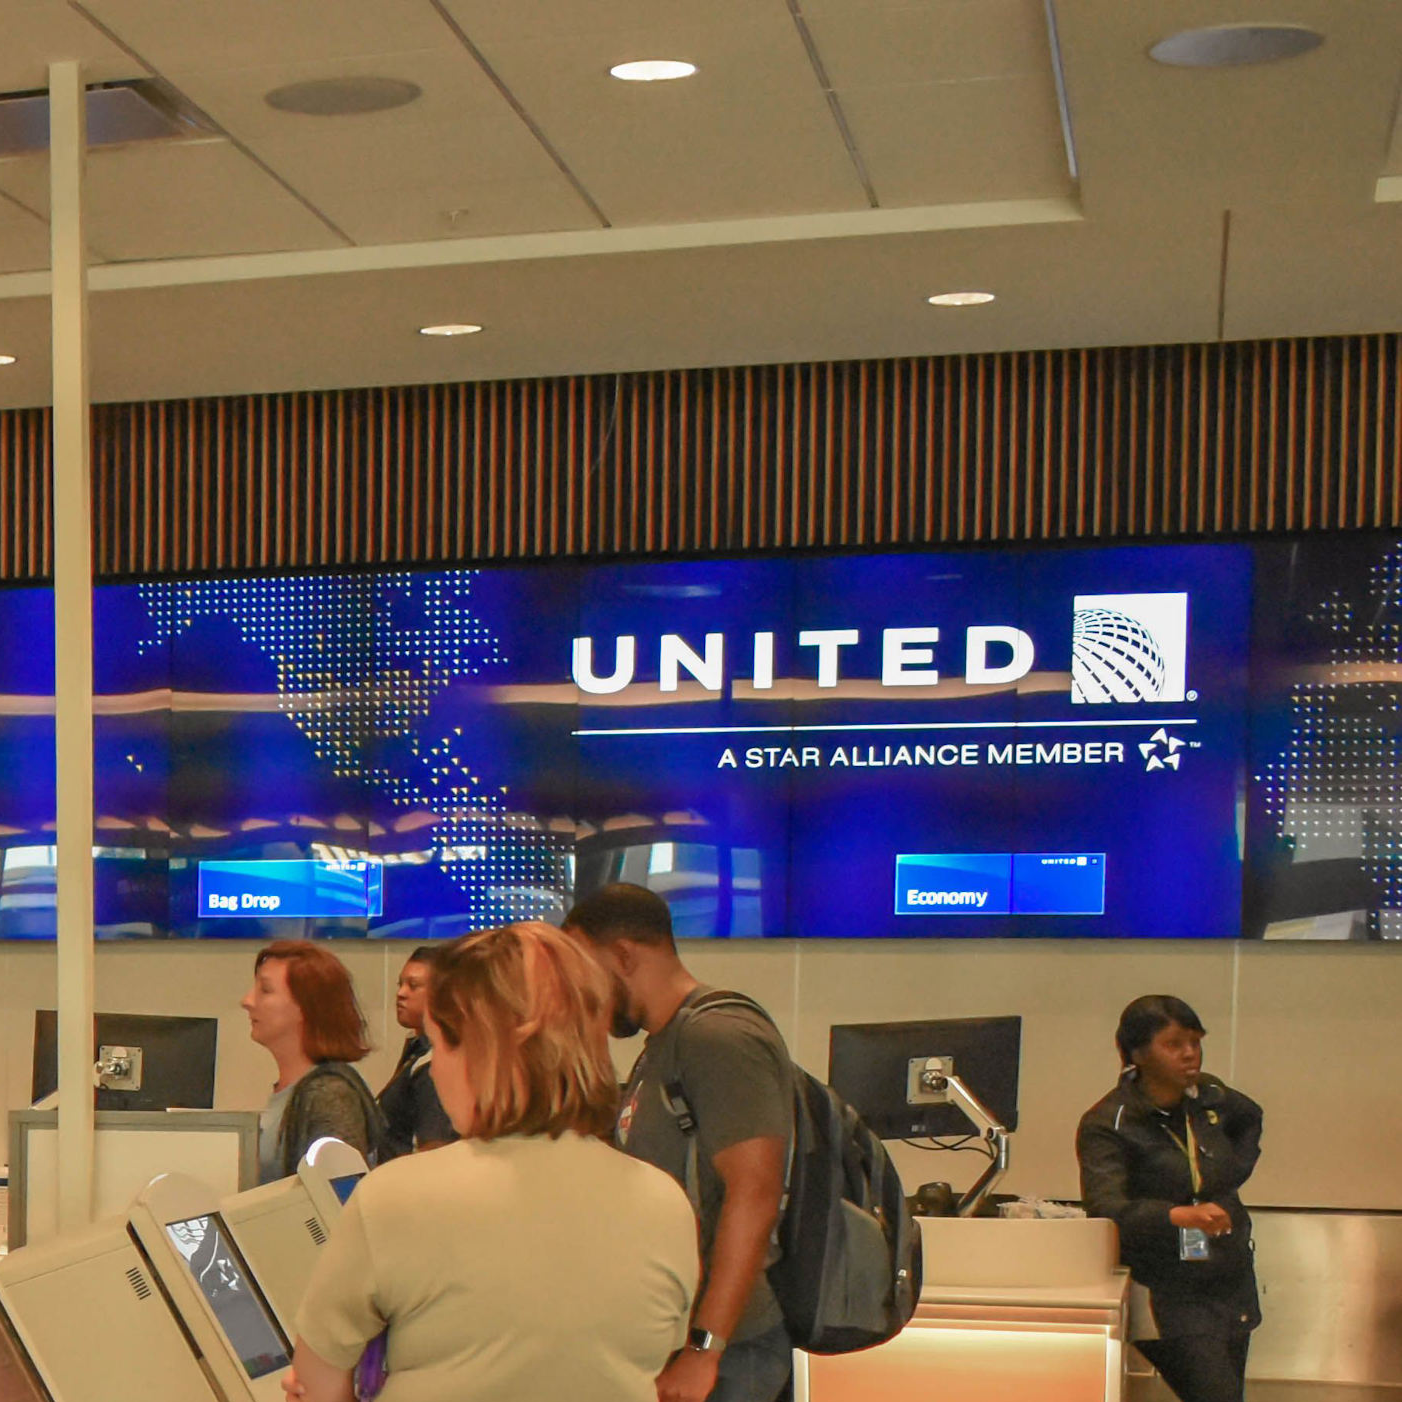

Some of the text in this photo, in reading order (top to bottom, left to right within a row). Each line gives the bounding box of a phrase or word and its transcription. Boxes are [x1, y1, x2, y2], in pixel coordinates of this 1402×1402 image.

[571, 625, 1034, 694] UNITED
[717, 741, 1124, 768] A STAR ALLIANCE MEMBER
[208, 893, 280, 911] Bag Drop
[907, 889, 988, 907] Economy
